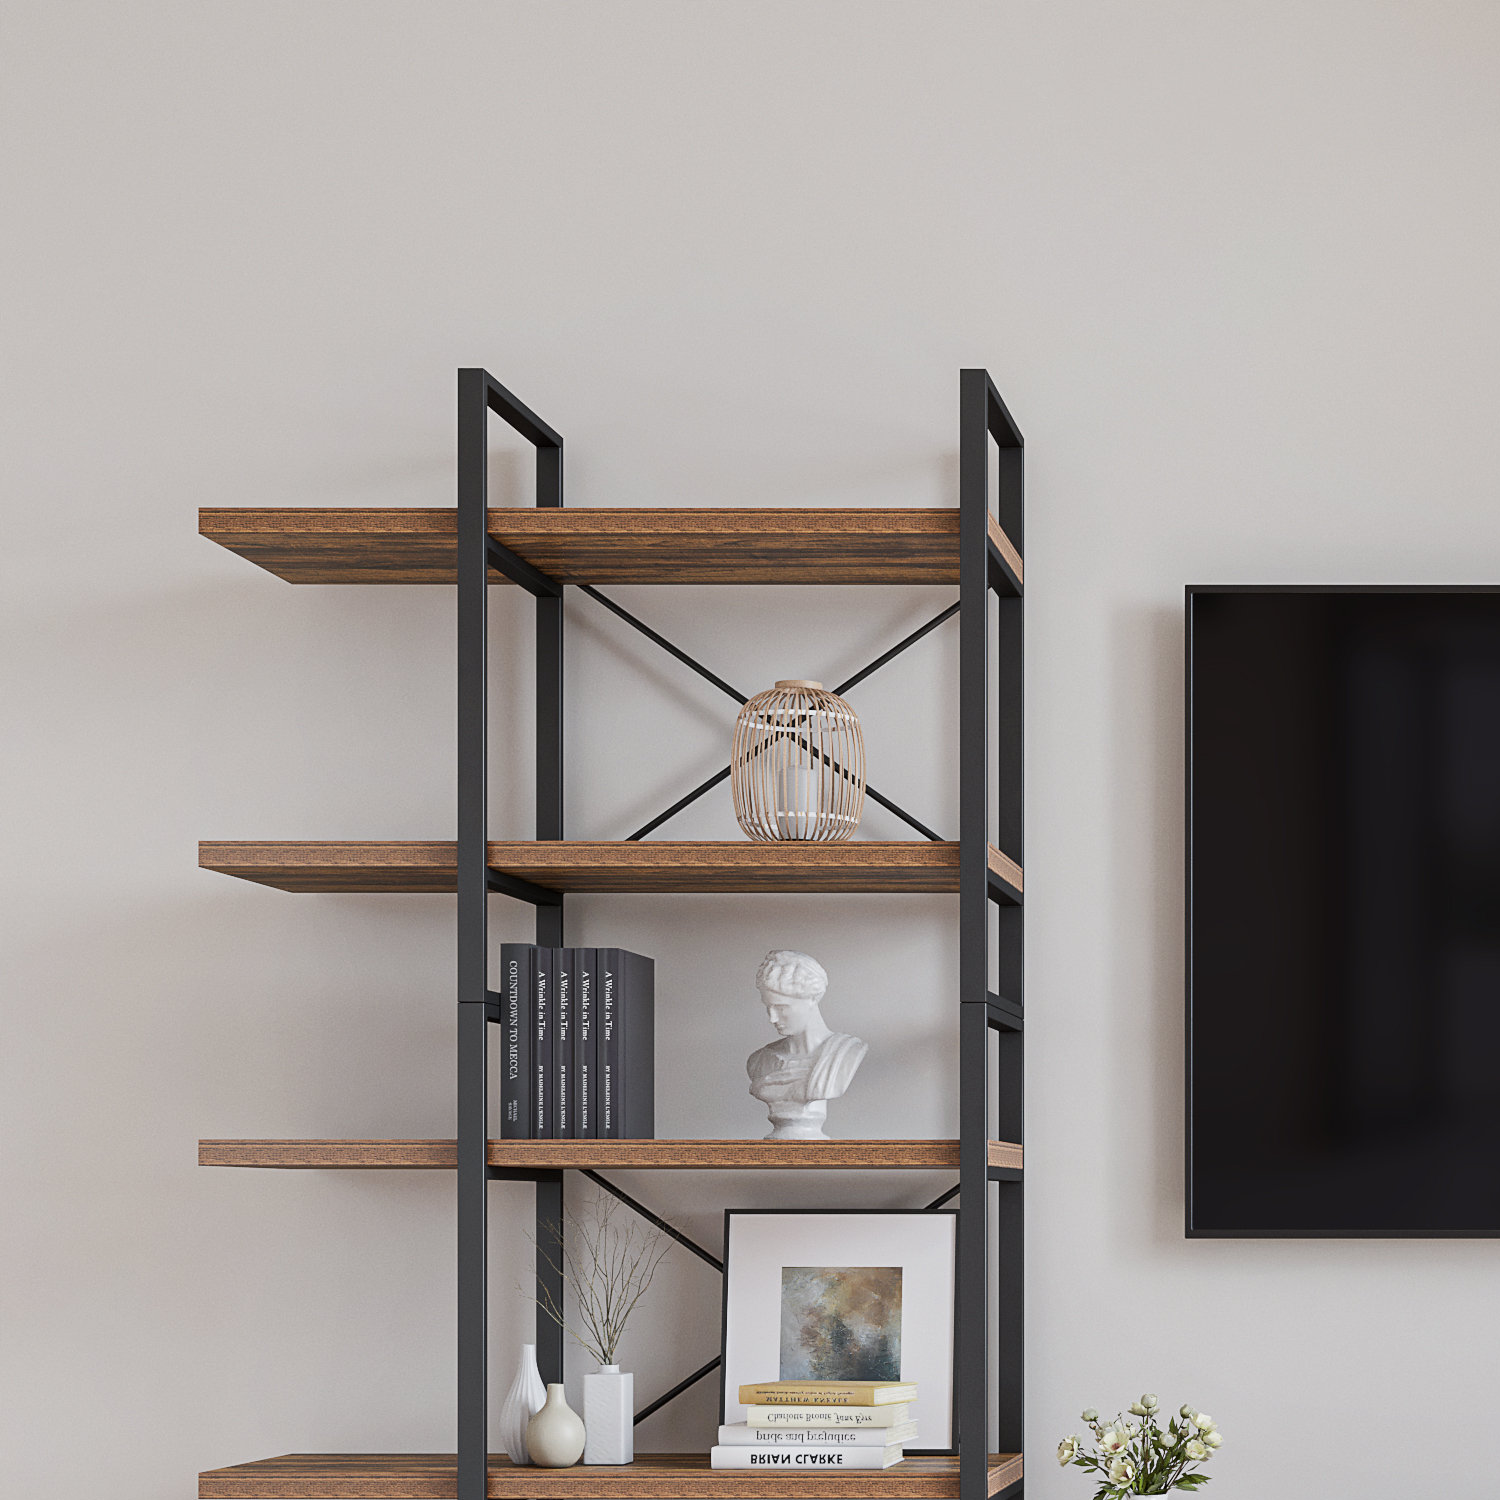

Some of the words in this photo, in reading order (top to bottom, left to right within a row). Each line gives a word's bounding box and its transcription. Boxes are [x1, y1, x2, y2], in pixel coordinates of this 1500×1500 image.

[509, 961, 518, 1026] COUNTDOWN
[538, 980, 546, 1010] Wrinkle
[560, 980, 568, 1010] Wrinkle
[582, 980, 590, 1010] Wrinkle
[605, 980, 613, 1010] Wrinkle
[538, 1012, 546, 1020] in
[560, 1012, 568, 1020] in
[582, 1012, 590, 1020] in
[605, 1012, 613, 1020] in
[509, 1029, 518, 1042] TO
[538, 1021, 546, 1041] Time
[560, 1021, 568, 1041] Time
[582, 1021, 590, 1041] Time
[605, 1021, 613, 1041] Time
[509, 1044, 518, 1080] MECCA
